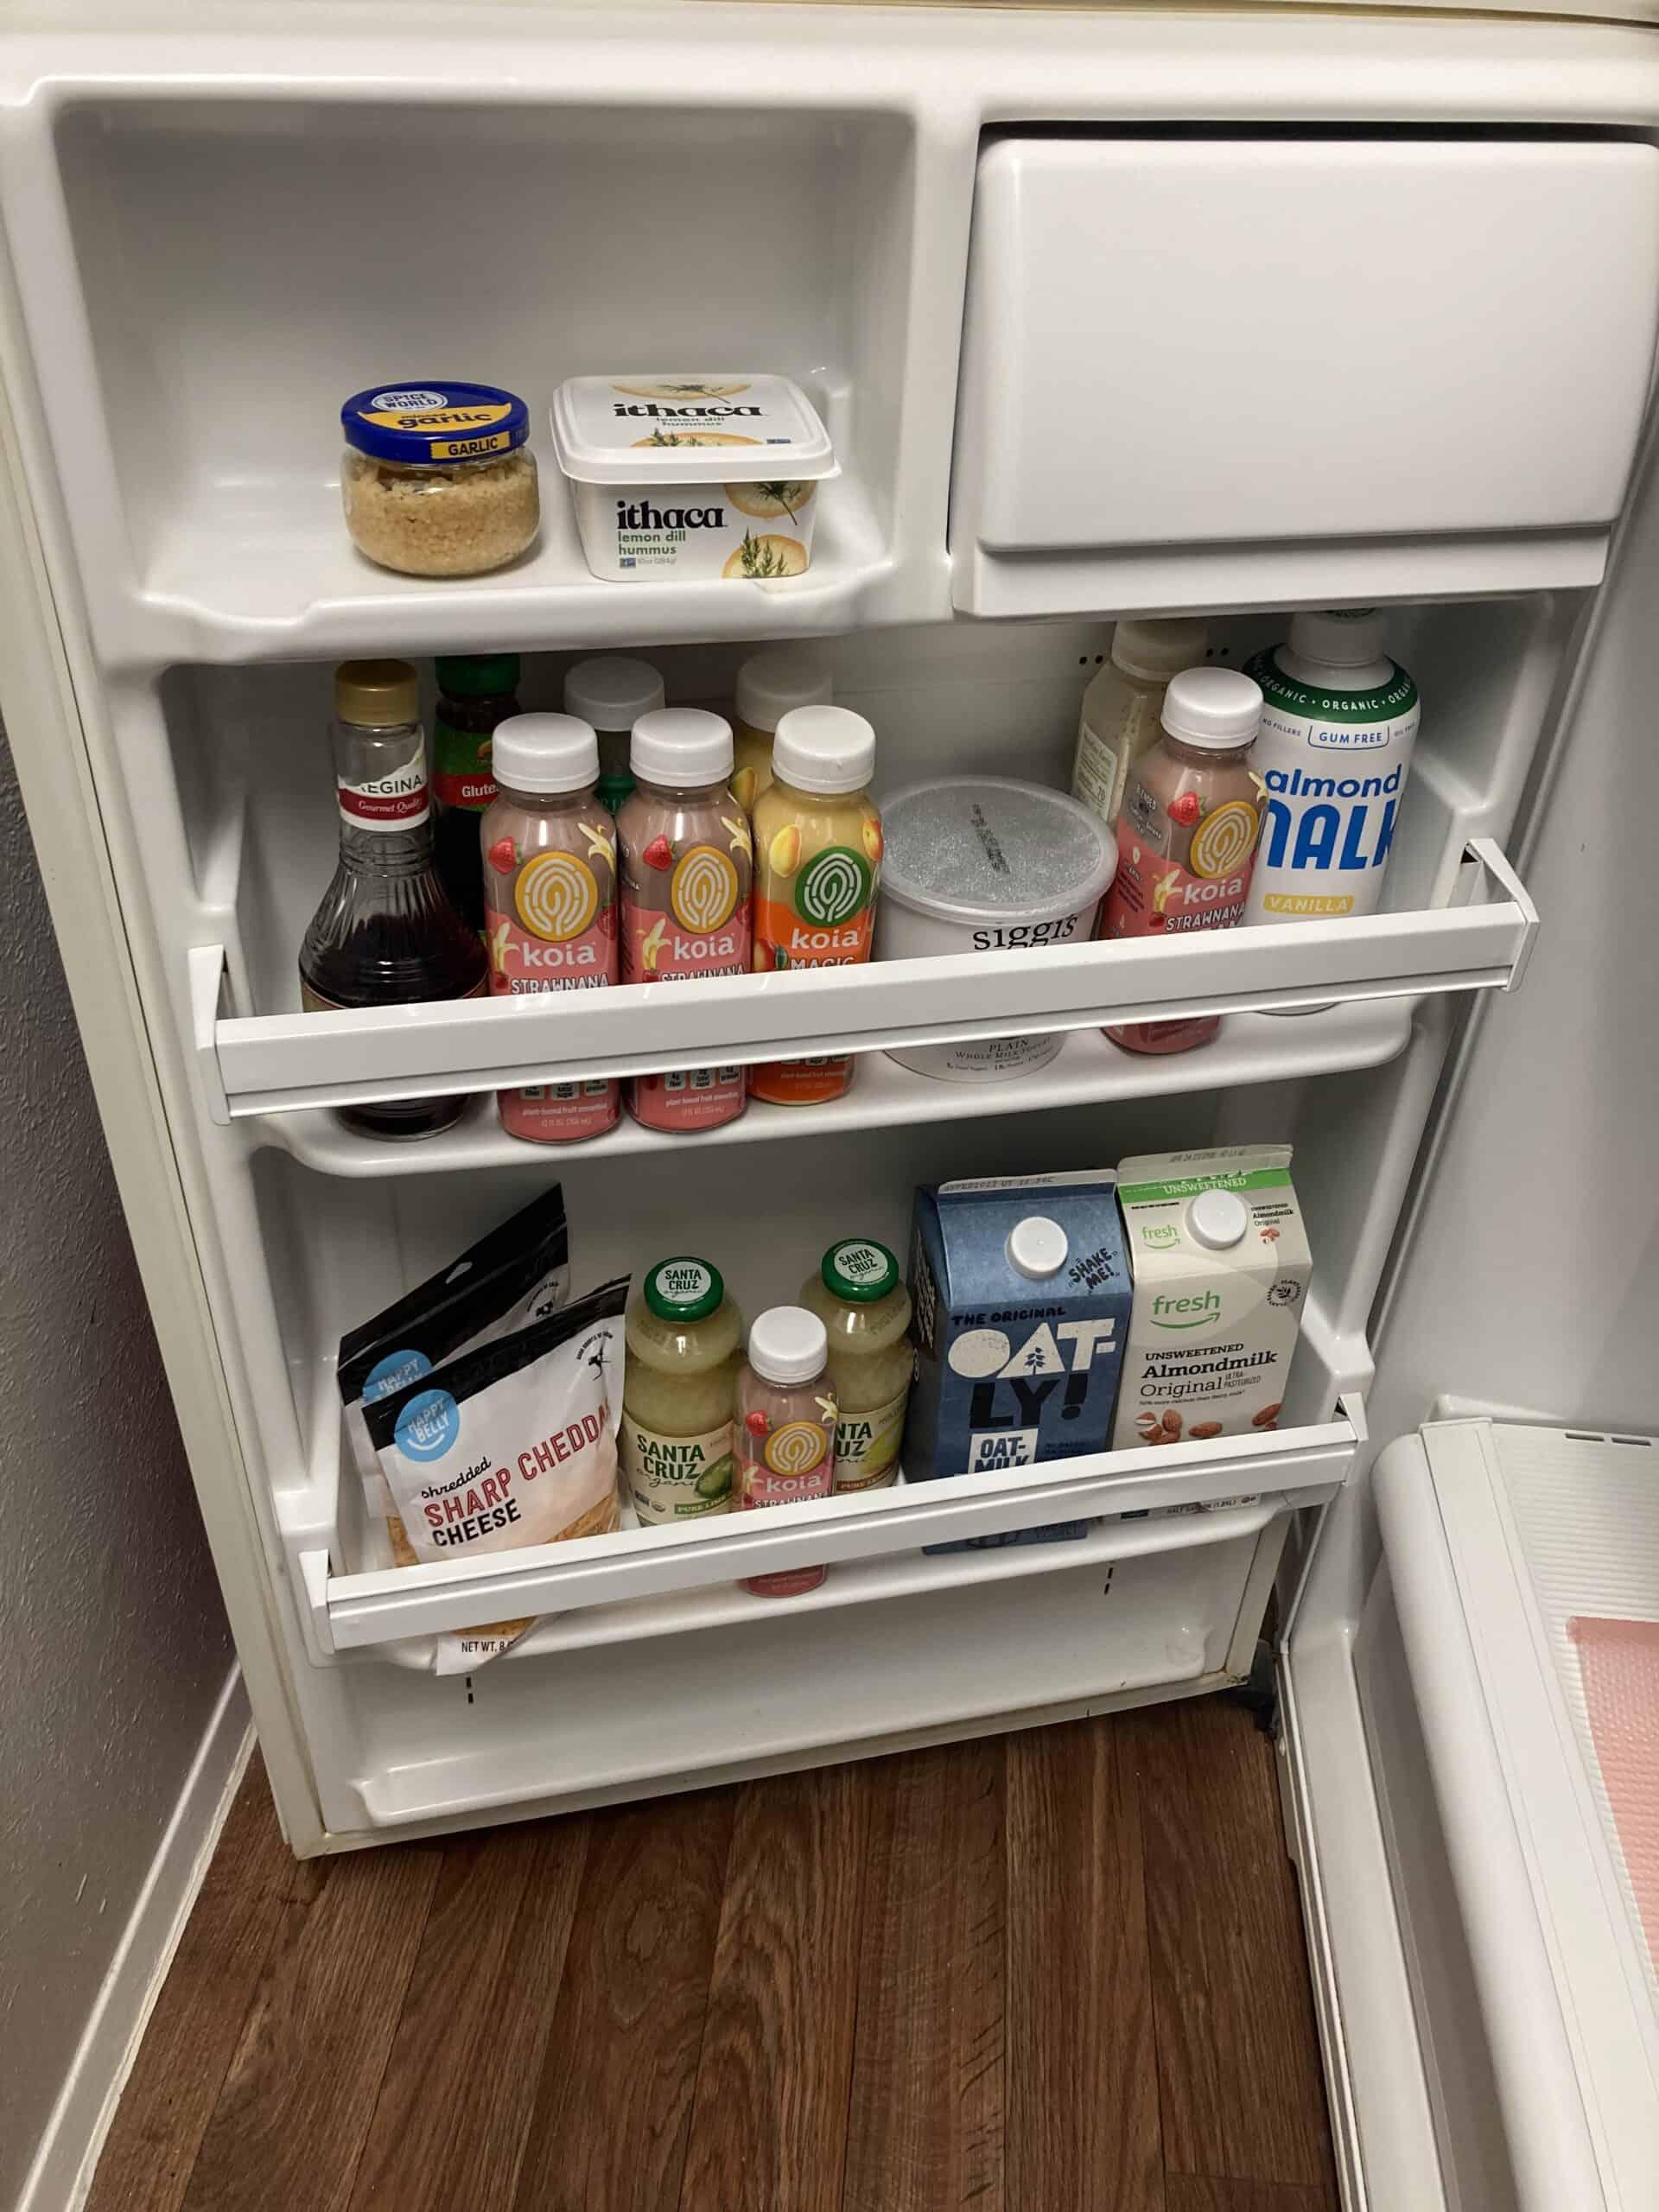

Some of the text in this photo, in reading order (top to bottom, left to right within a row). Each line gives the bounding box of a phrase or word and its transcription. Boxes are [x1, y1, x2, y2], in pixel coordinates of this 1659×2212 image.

[384, 392, 428, 402] SPICE
[385, 399, 438, 408] WORLD
[613, 404, 763, 416] ithaca
[397, 413, 493, 429] garlic
[448, 437, 499, 456] GARLIC
[616, 499, 728, 530] ithaca
[618, 530, 686, 543] lemon dill
[619, 543, 677, 556] hummus
[1261, 675, 1307, 704] ORGANIC
[1322, 699, 1380, 711] ORGANIC
[1262, 718, 1301, 737] NO FILLERS
[1319, 732, 1383, 744] GUM FREE
[363, 774, 423, 794] EGINA
[1264, 762, 1402, 798] almond
[461, 783, 498, 798] Glute
[358, 799, 395, 813] Gourmet
[1183, 876, 1243, 906] koia
[1270, 895, 1349, 912] VANILLA
[1166, 901, 1246, 932] STRAWNANA
[673, 934, 734, 962] koia
[791, 927, 860, 950] koia
[523, 941, 596, 968] koia
[1141, 1224, 1179, 1240] fresh
[838, 1249, 875, 1266] SANTA
[849, 1258, 878, 1274] CRUZ
[1068, 1247, 1113, 1283] SHAKE
[664, 1269, 702, 1281] SANTA
[669, 1280, 700, 1290] CRUZ
[1085, 1262, 1116, 1290] ME!
[1153, 1290, 1221, 1315] fresh
[951, 1306, 1067, 1326] THE ORIGINAL
[1145, 1343, 1244, 1362] UNSWEETENED
[378, 1357, 419, 1391] HAPPY
[1141, 1350, 1279, 1379] Almondmilk
[1140, 1377, 1223, 1399] Original
[969, 1372, 1089, 1429] LY!
[407, 1396, 444, 1434] HAPPY
[415, 1409, 449, 1443] BELLY
[836, 1421, 873, 1440] NTA
[637, 1433, 706, 1463] SANTA
[836, 1440, 867, 1458] UZ
[980, 1436, 1027, 1459] OAT-
[421, 1456, 493, 1499] shredded
[643, 1456, 701, 1480] CRUZ
[766, 1474, 822, 1493] koia
[423, 1467, 512, 1528] SHARP
[431, 1497, 522, 1548] CHEESE
[461, 1641, 505, 1653] NET WT. 8
